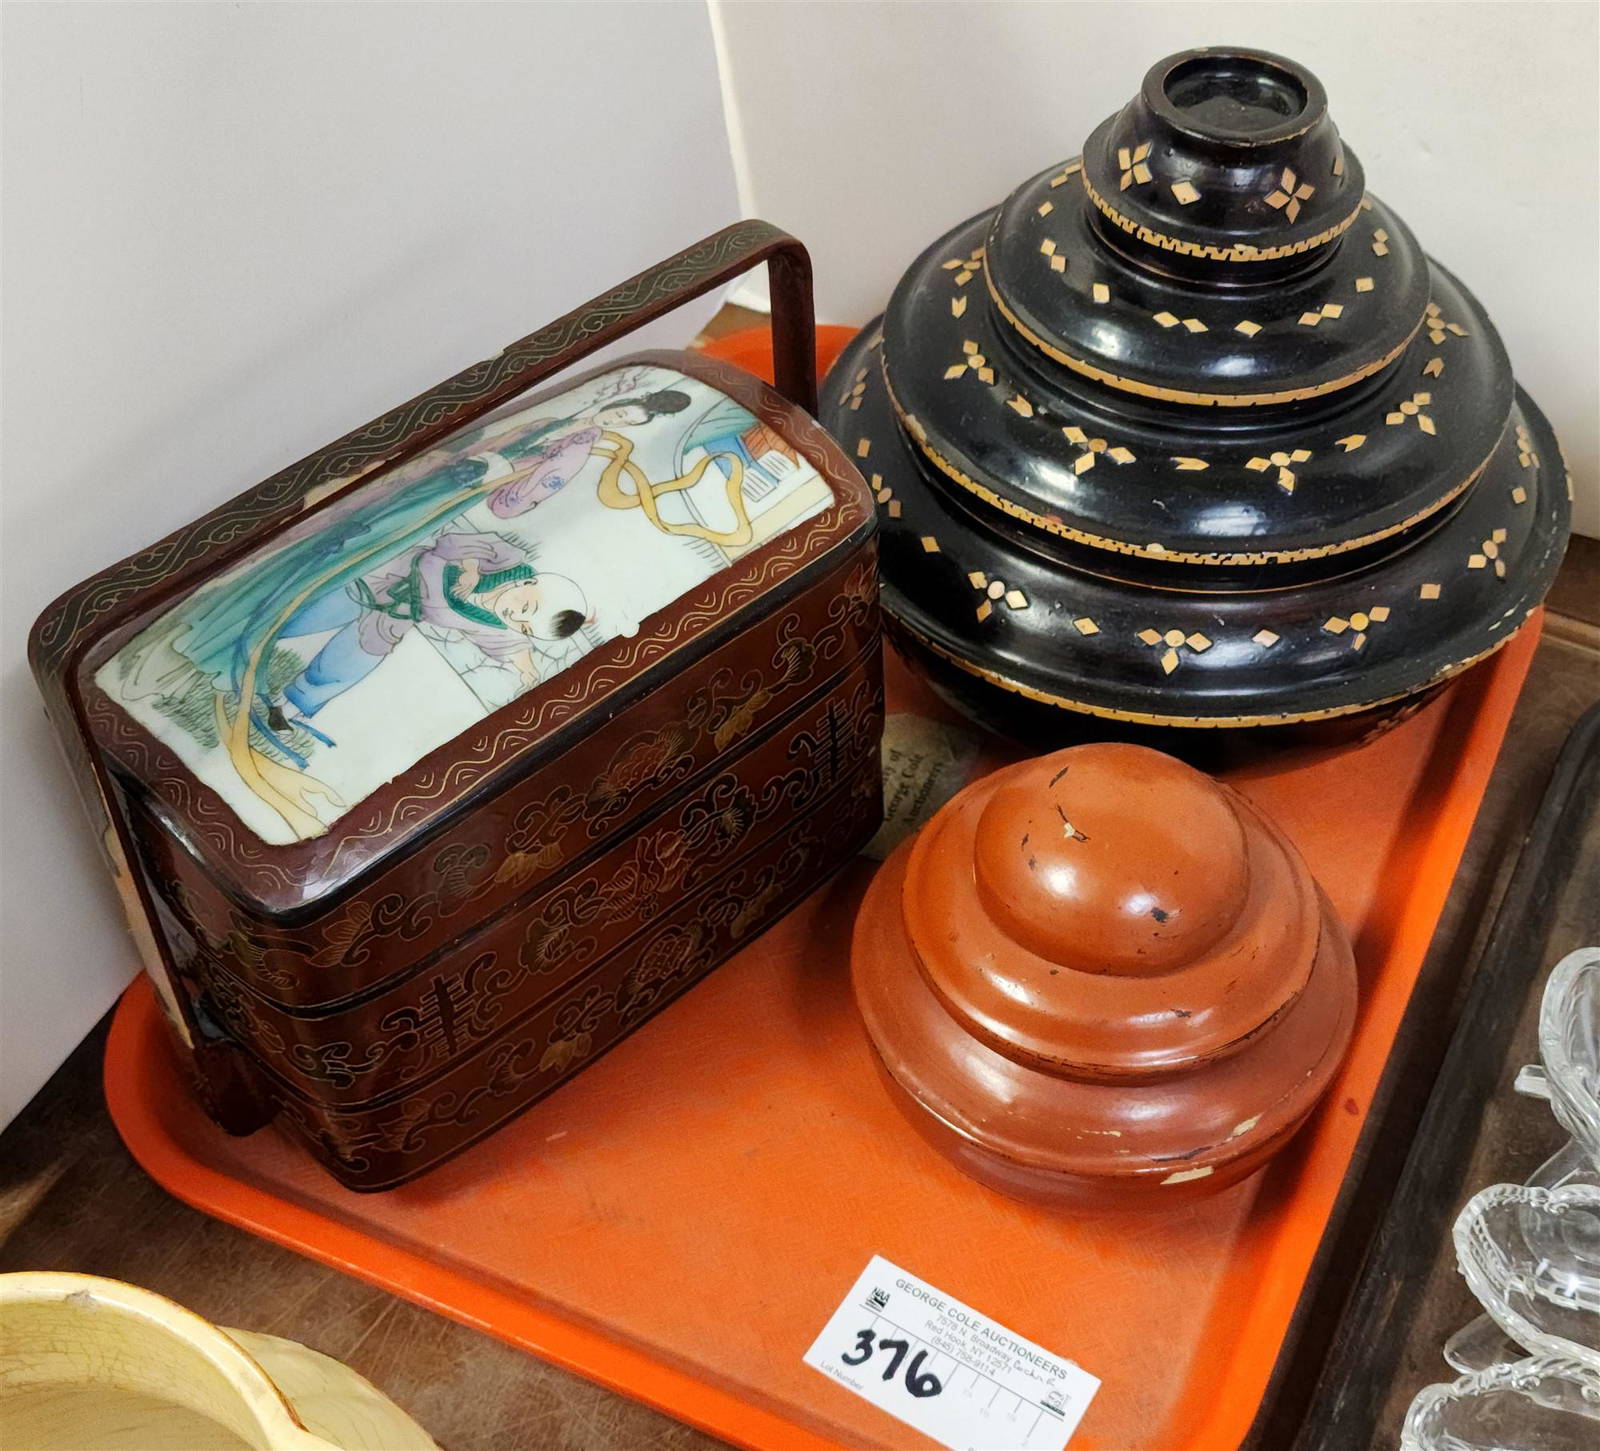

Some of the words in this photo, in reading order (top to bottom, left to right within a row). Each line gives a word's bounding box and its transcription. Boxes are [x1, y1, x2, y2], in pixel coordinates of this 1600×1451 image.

[900, 752, 925, 780] Cole
[895, 1278, 946, 1312] GEORGE
[947, 1307, 980, 1331] COLE
[981, 1326, 1067, 1380] AUCTIONEERS
[925, 1320, 943, 1334] Red
[970, 1345, 984, 1357] NY
[841, 1328, 942, 1397] 376
[970, 1334, 1013, 1364] Broadway
[820, 1361, 833, 1372] Lot
[833, 1369, 863, 1390] Number
